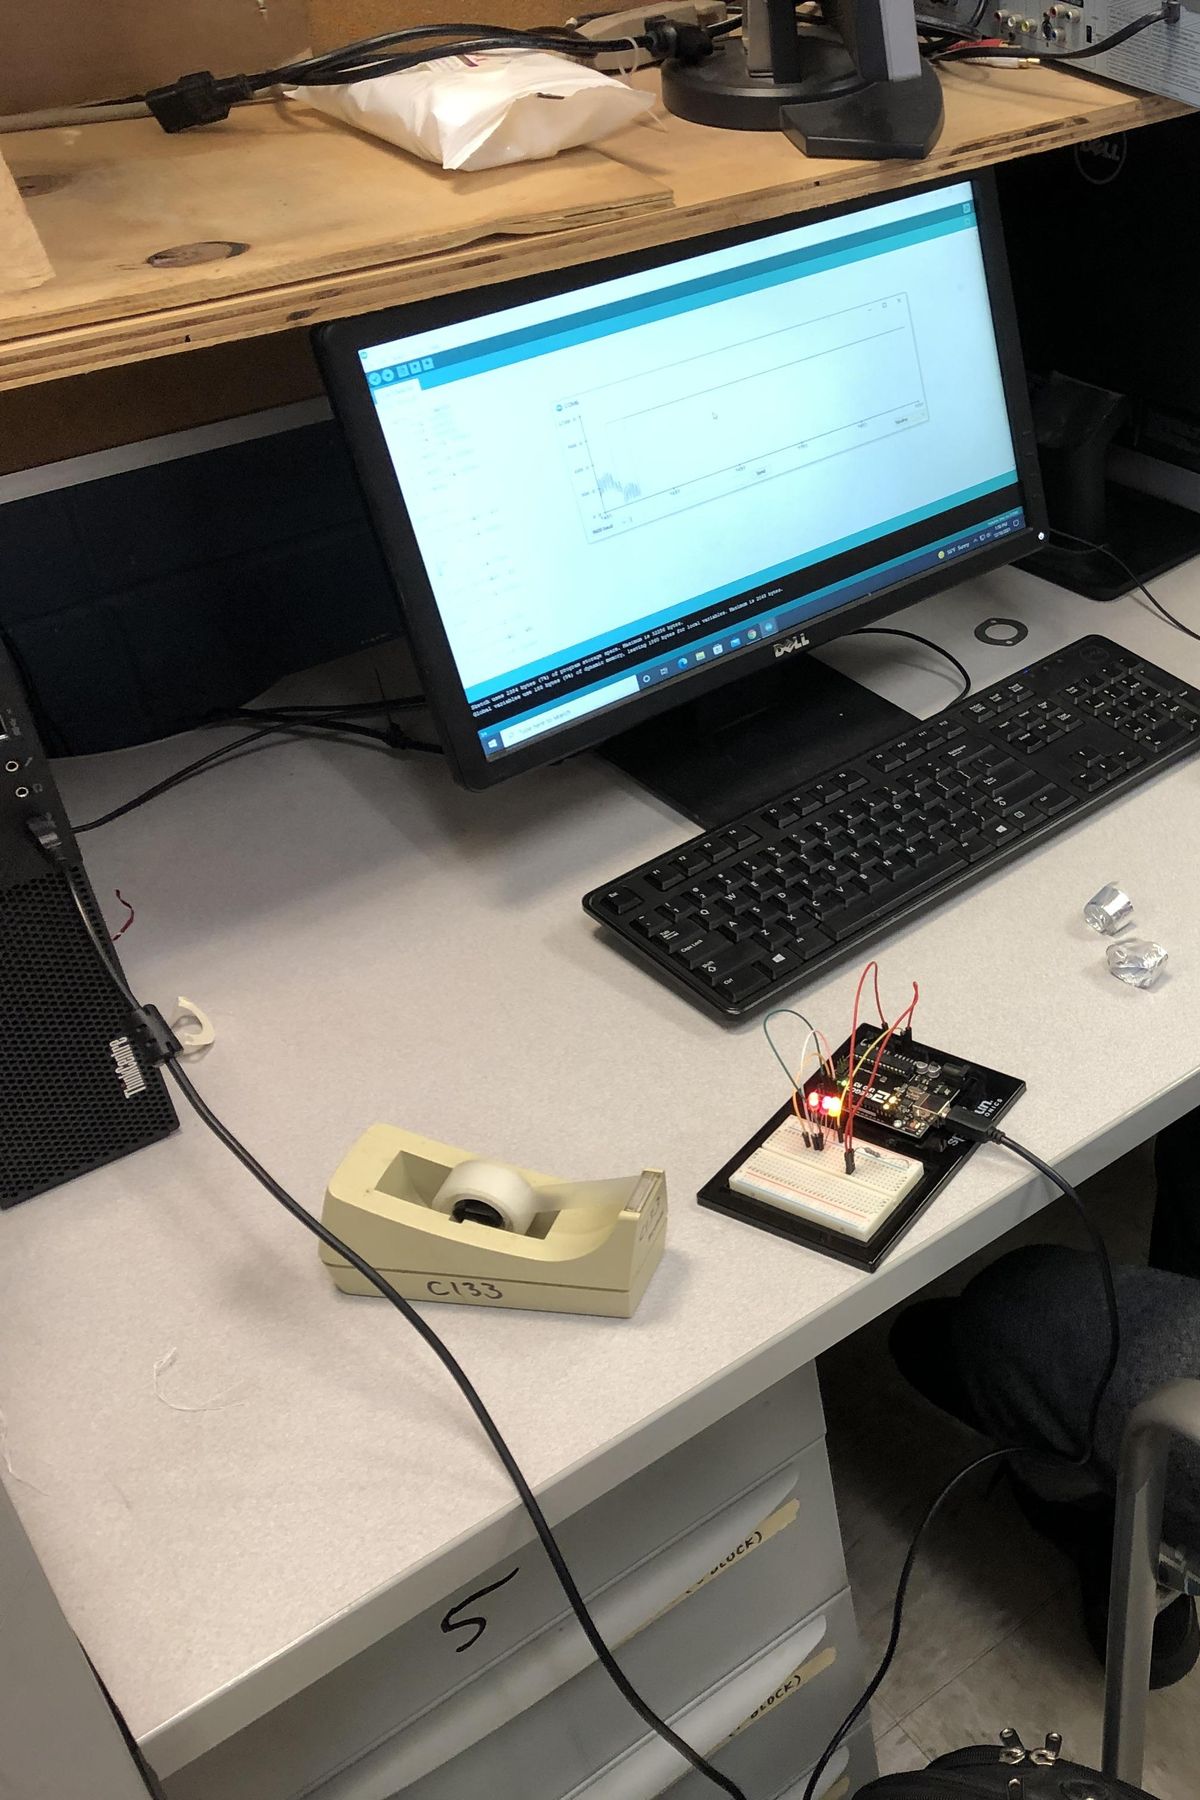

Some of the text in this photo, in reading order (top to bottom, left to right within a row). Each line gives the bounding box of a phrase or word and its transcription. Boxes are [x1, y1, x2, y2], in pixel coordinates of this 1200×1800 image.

[471, 700, 490, 710] Sketch
[492, 694, 504, 702] uses
[520, 681, 536, 692] bytes
[551, 670, 558, 678] of
[560, 662, 582, 676] program
[582, 654, 602, 667] storage
[604, 646, 621, 656] space.
[622, 638, 642, 649] Maximum
[666, 621, 684, 630] bytes.
[472, 705, 492, 718] Global
[494, 694, 521, 710] variables
[545, 678, 561, 690] bytes
[575, 668, 582, 676] of
[584, 660, 604, 672] dynamic
[606, 652, 626, 663] memory,
[627, 644, 647, 654] leaving
[660, 631, 676, 641] bytes
[687, 620, 700, 630] local
[702, 611, 728, 624] variables.
[728, 601, 748, 612] Maximum
[768, 588, 784, 598] bytes.
[773, 633, 810, 658] DELL
[109, 1036, 146, 1099] ThinkCentre
[427, 1281, 503, 1300] C133
[440, 1567, 520, 1653] 5
